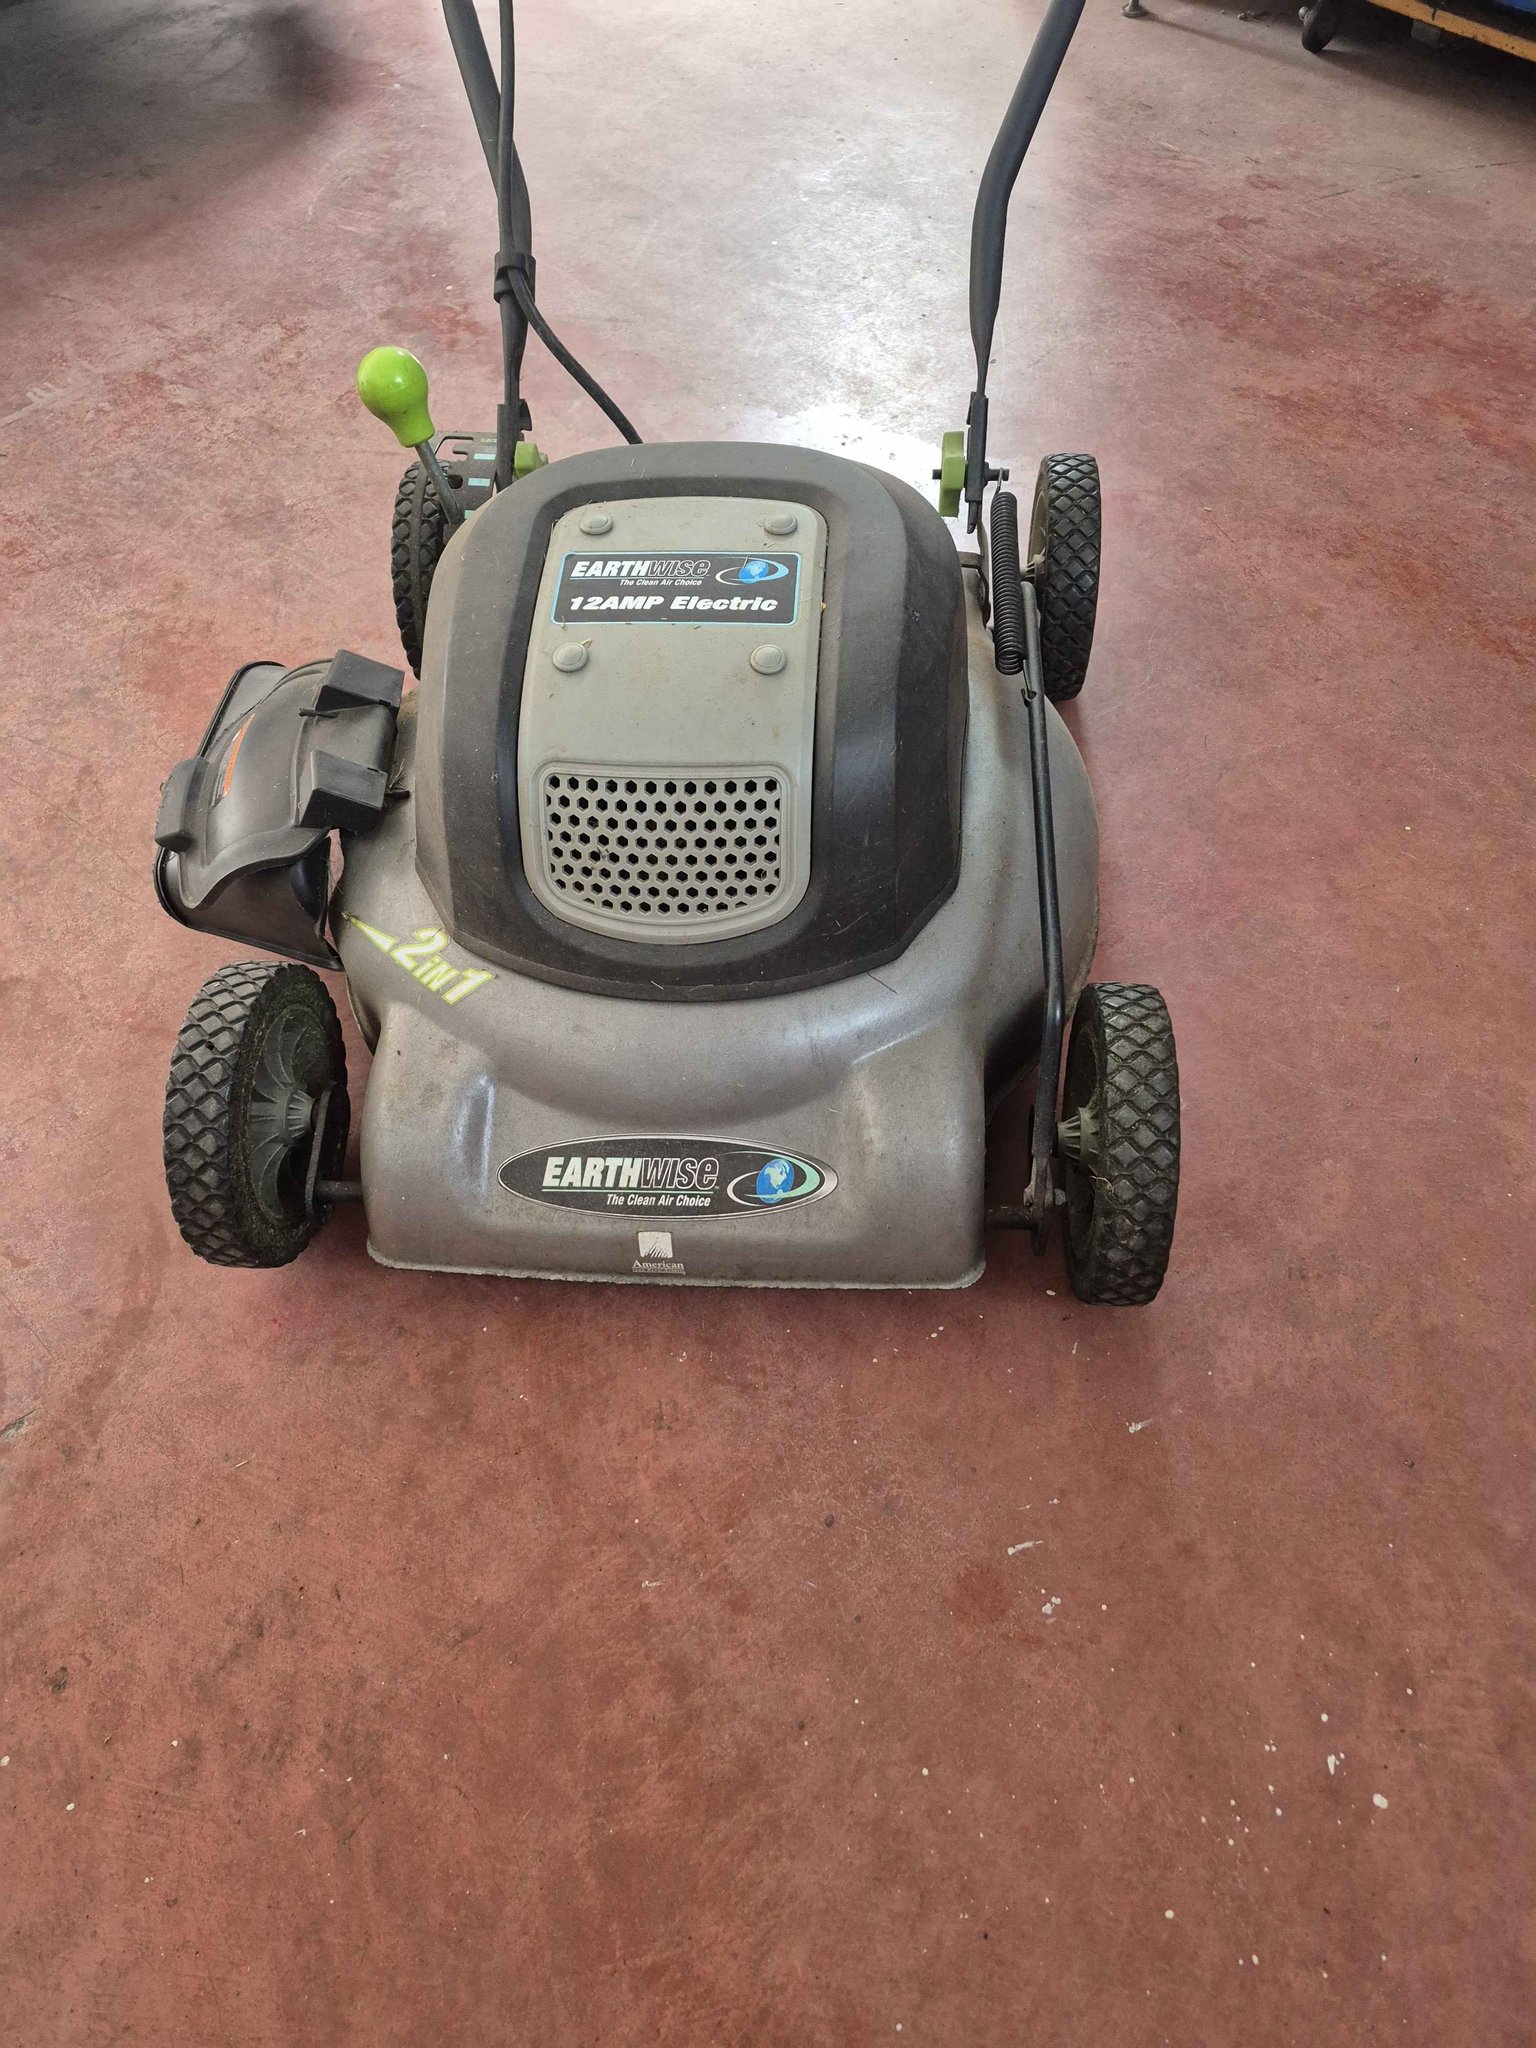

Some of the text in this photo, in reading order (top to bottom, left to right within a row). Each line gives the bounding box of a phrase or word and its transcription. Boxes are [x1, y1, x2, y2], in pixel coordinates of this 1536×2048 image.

[674, 579, 703, 587] Choice
[570, 595, 778, 611] 12AMP Electric
[606, 1193, 711, 1207] The Clean Air Choice
[632, 1259, 685, 1268] American
